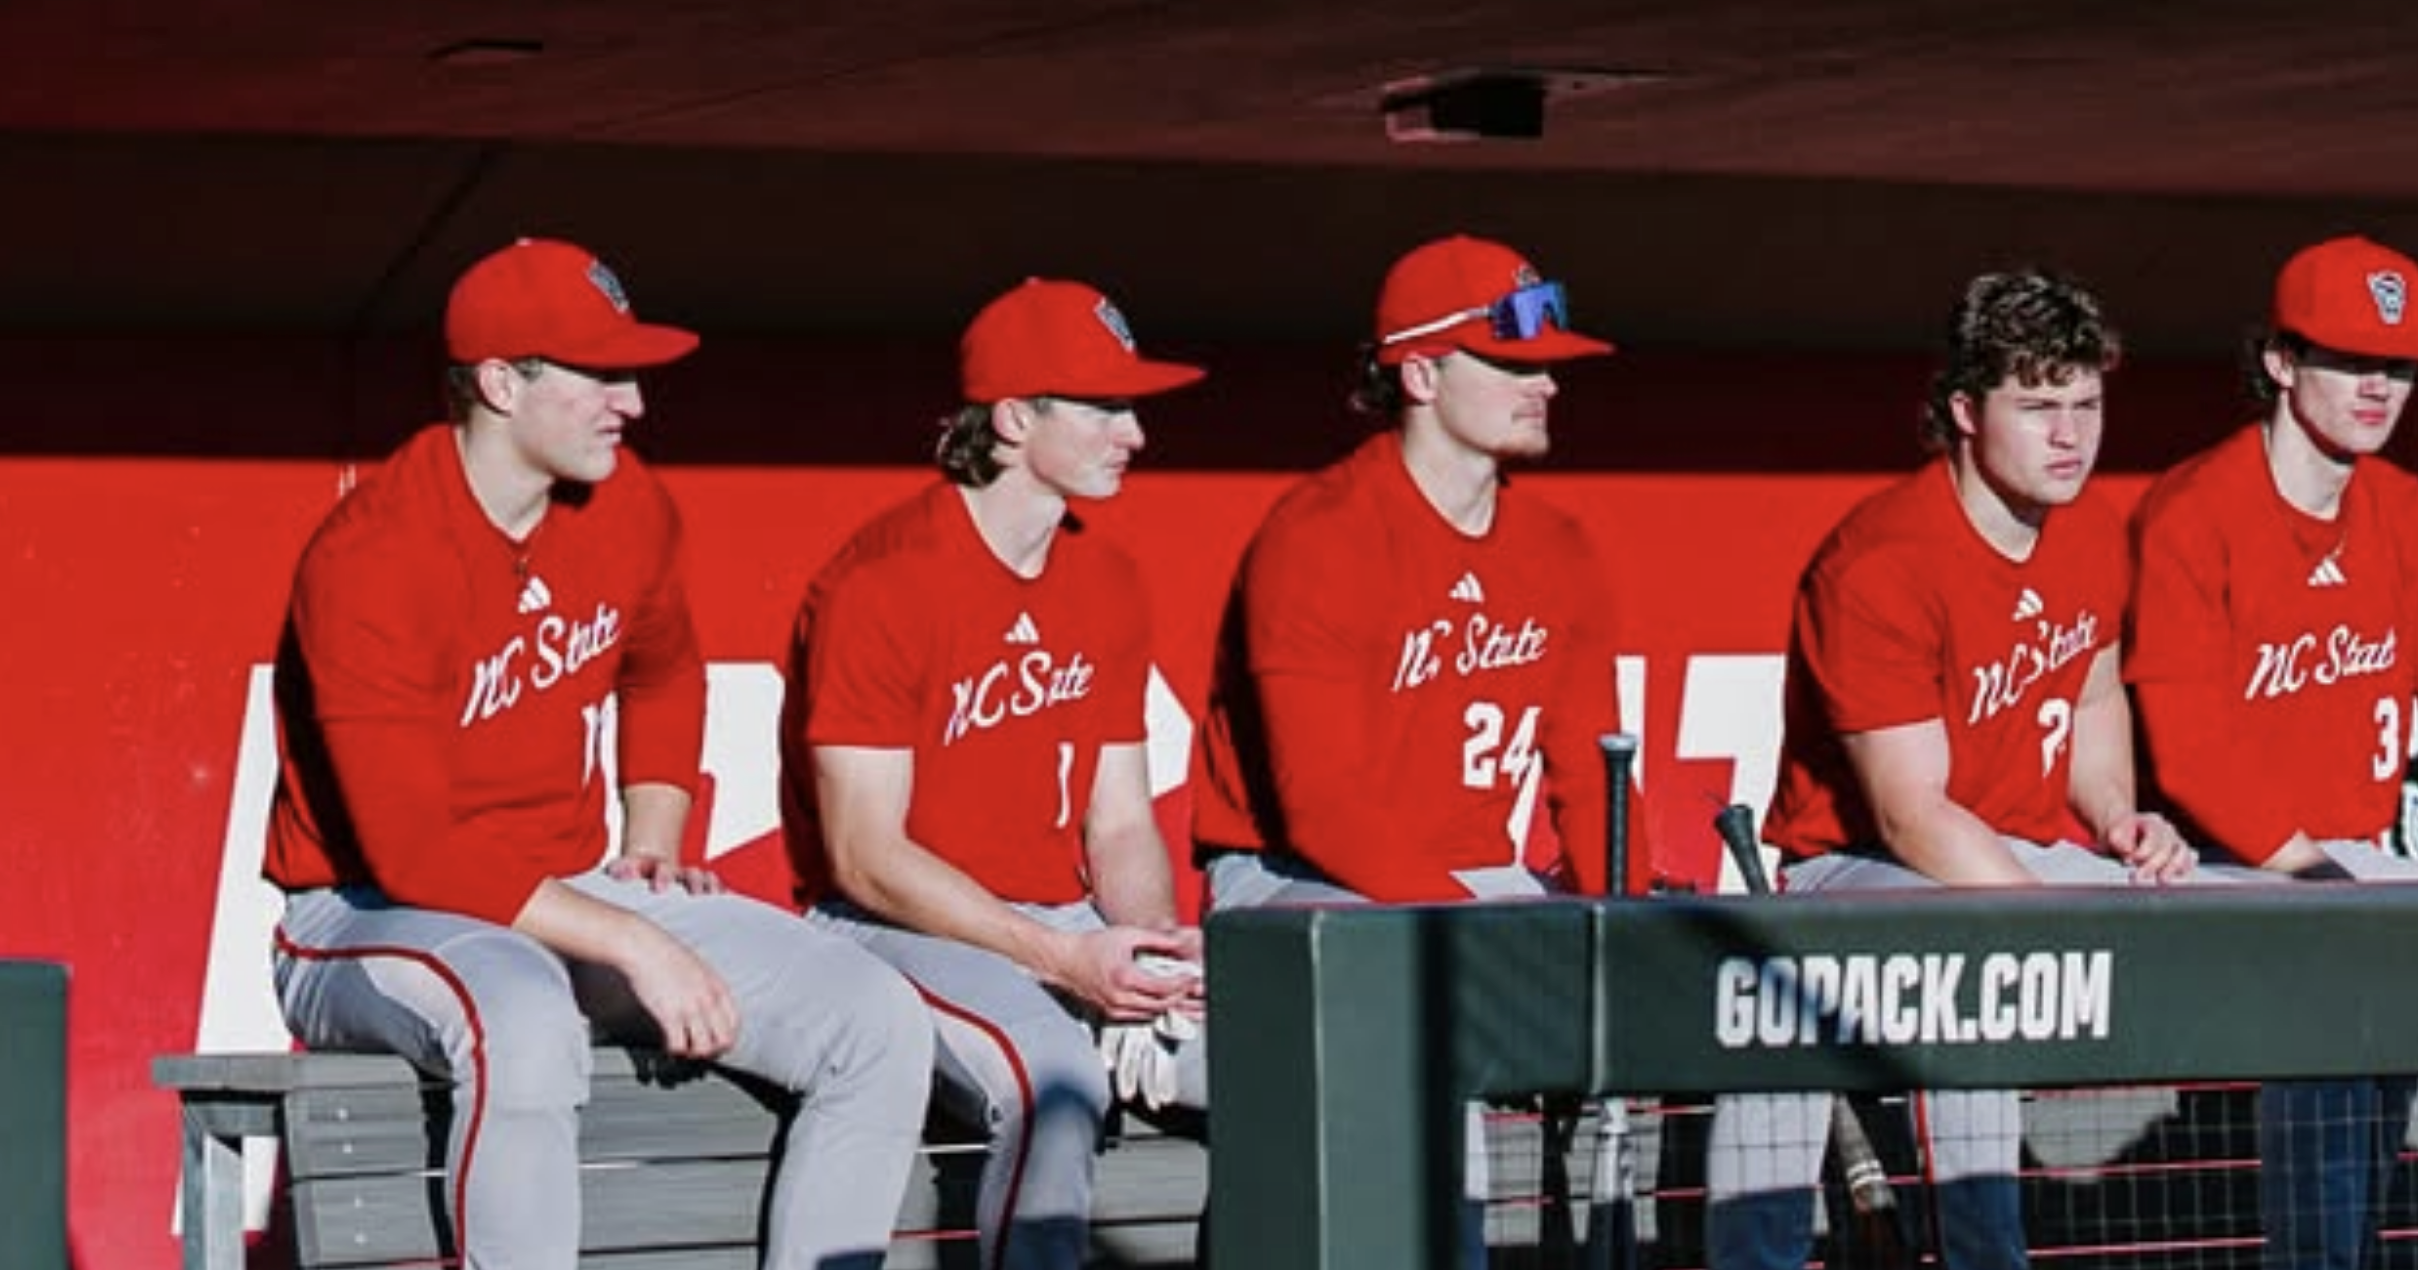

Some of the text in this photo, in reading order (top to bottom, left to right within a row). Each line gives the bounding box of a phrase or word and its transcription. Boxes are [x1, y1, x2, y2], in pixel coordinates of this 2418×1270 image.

[460, 601, 621, 728] NC State
[1456, 612, 1548, 677] State
[2245, 623, 2397, 701] NC Stat
[1462, 699, 1543, 790] 24
[1714, 949, 2114, 1049] GOPACK.COM
